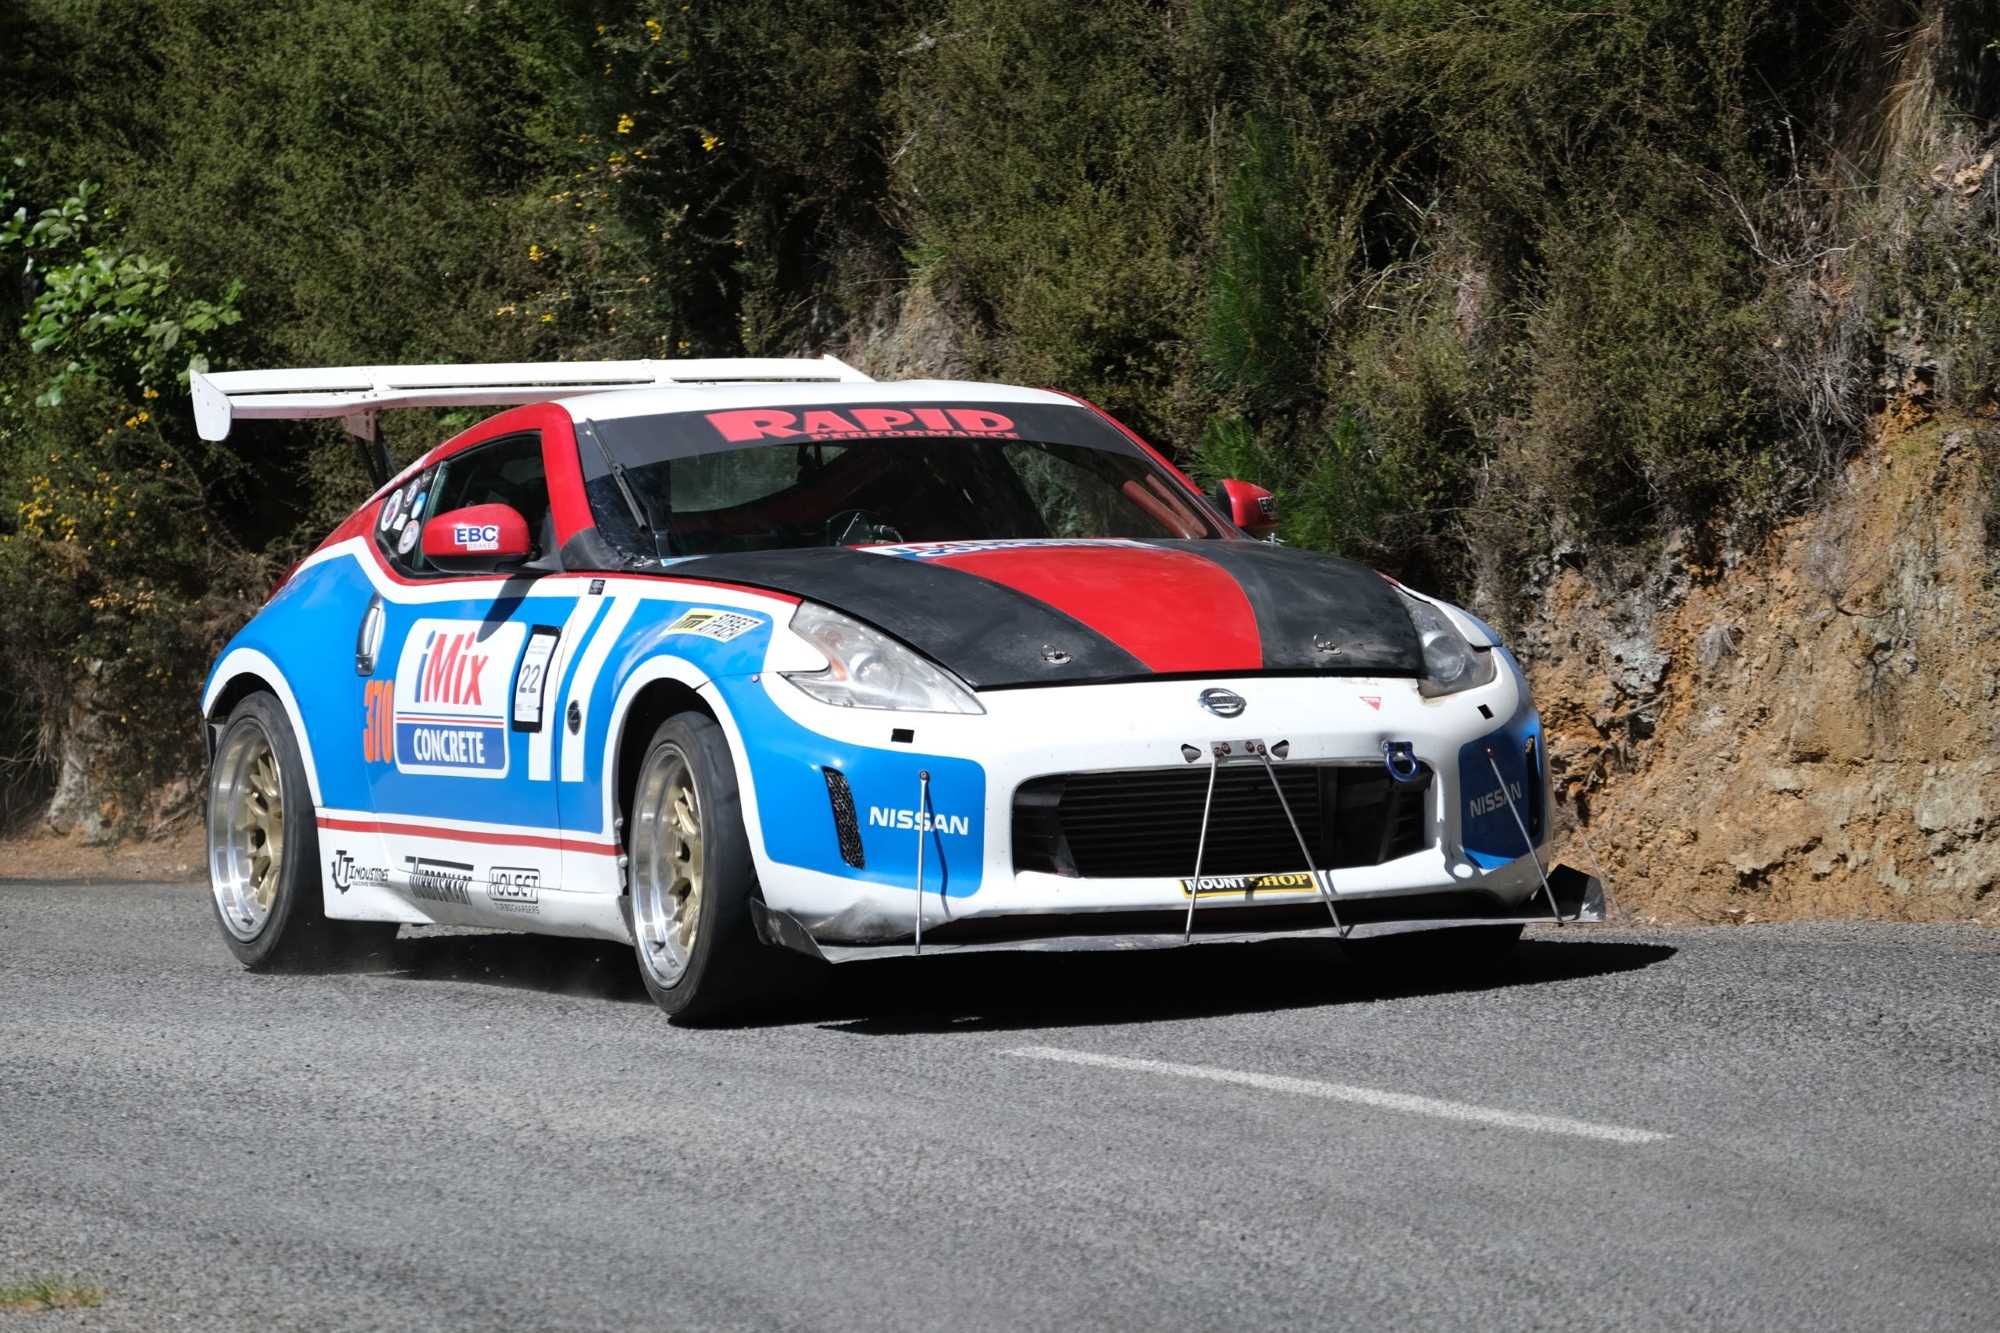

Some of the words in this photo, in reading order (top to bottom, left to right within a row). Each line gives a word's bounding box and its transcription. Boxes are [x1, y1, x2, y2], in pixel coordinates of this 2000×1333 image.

[704, 408, 1015, 442] RAPID
[456, 527, 497, 543] EBC
[414, 630, 489, 706] iMix
[519, 664, 541, 694] 22
[363, 680, 394, 764] 370
[413, 728, 486, 764] CONCRETE
[869, 806, 969, 836] NISSAN
[487, 873, 538, 898] HOLSET
[1184, 877, 1245, 891] MOUNT
[1248, 873, 1308, 887] SHOP
